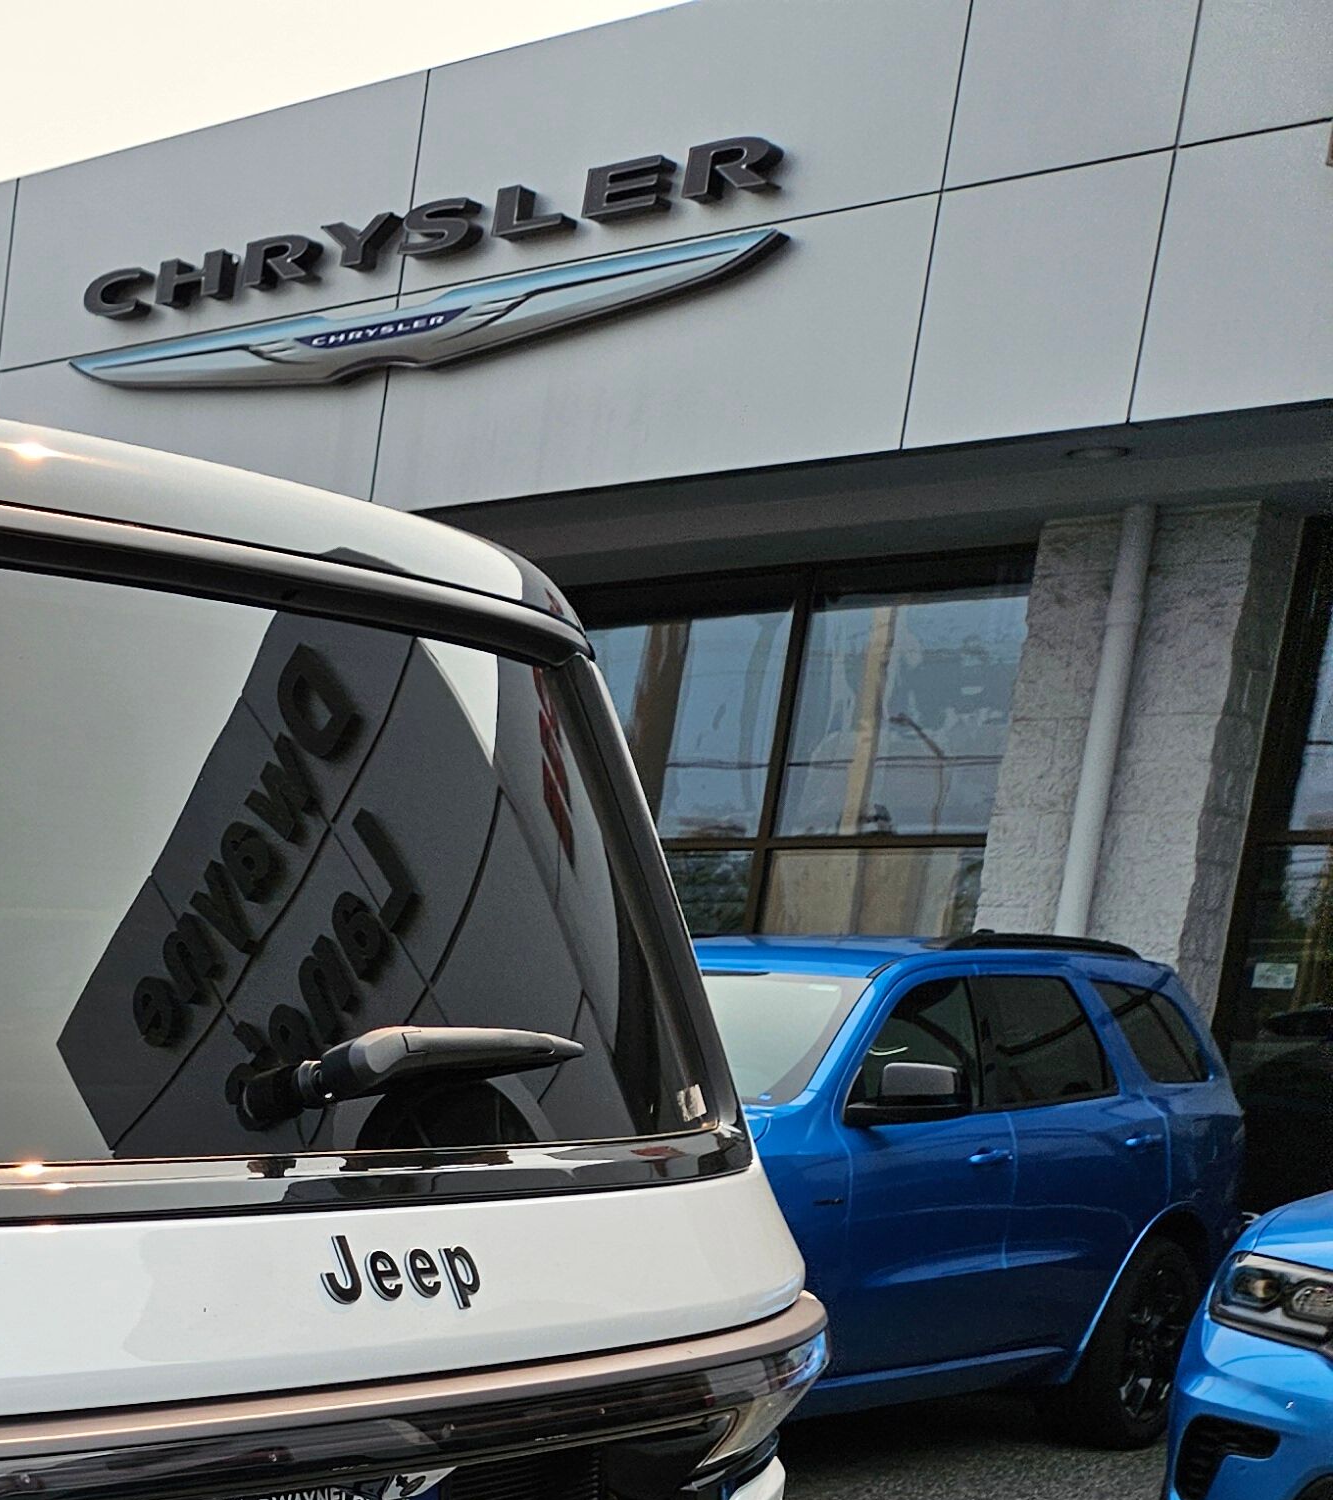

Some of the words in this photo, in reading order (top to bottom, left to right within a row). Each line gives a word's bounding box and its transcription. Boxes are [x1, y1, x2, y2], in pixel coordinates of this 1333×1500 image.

[84, 135, 786, 319] CHRYSLER
[310, 313, 446, 348] CHRYSLER
[319, 1234, 481, 1310] Jeep
